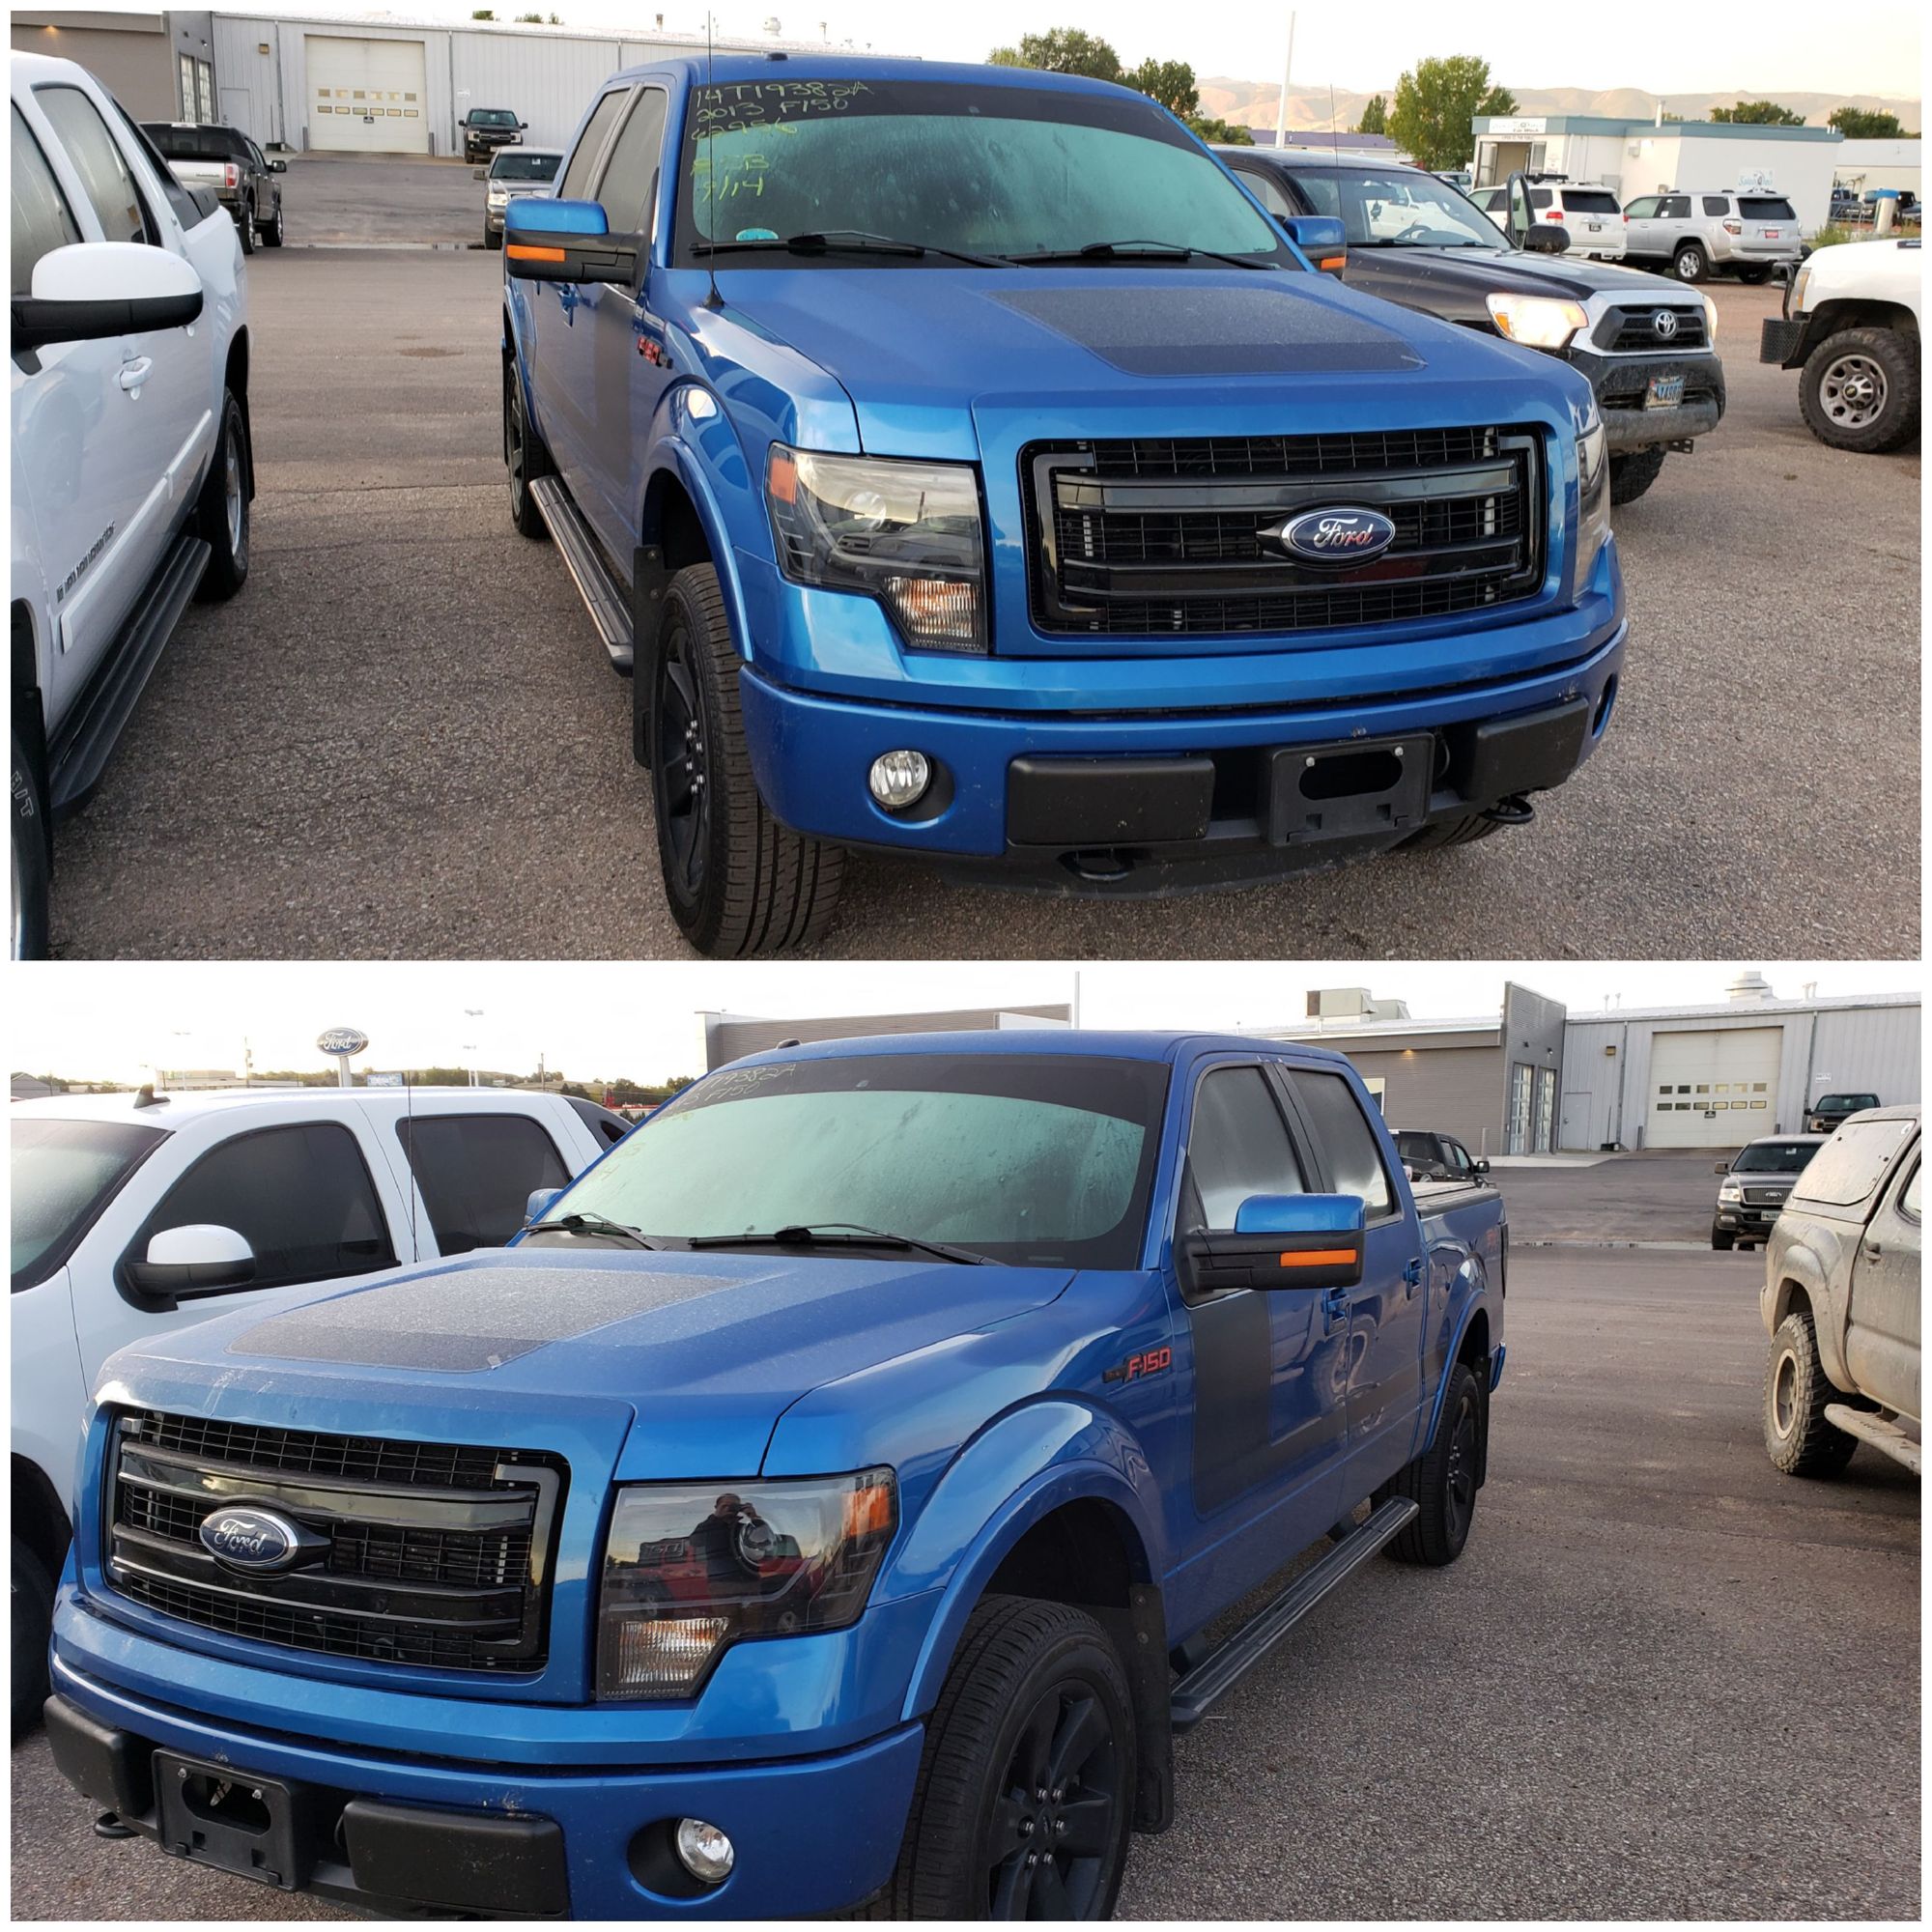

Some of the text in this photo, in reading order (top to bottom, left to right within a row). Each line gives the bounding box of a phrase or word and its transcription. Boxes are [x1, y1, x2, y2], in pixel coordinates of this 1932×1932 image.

[696, 99, 848, 123] 2013 F150
[1314, 518, 1374, 549] Ford
[324, 1032, 352, 1050] Ford
[1128, 1347, 1172, 1379] F-150
[213, 1518, 266, 1554] Ford
